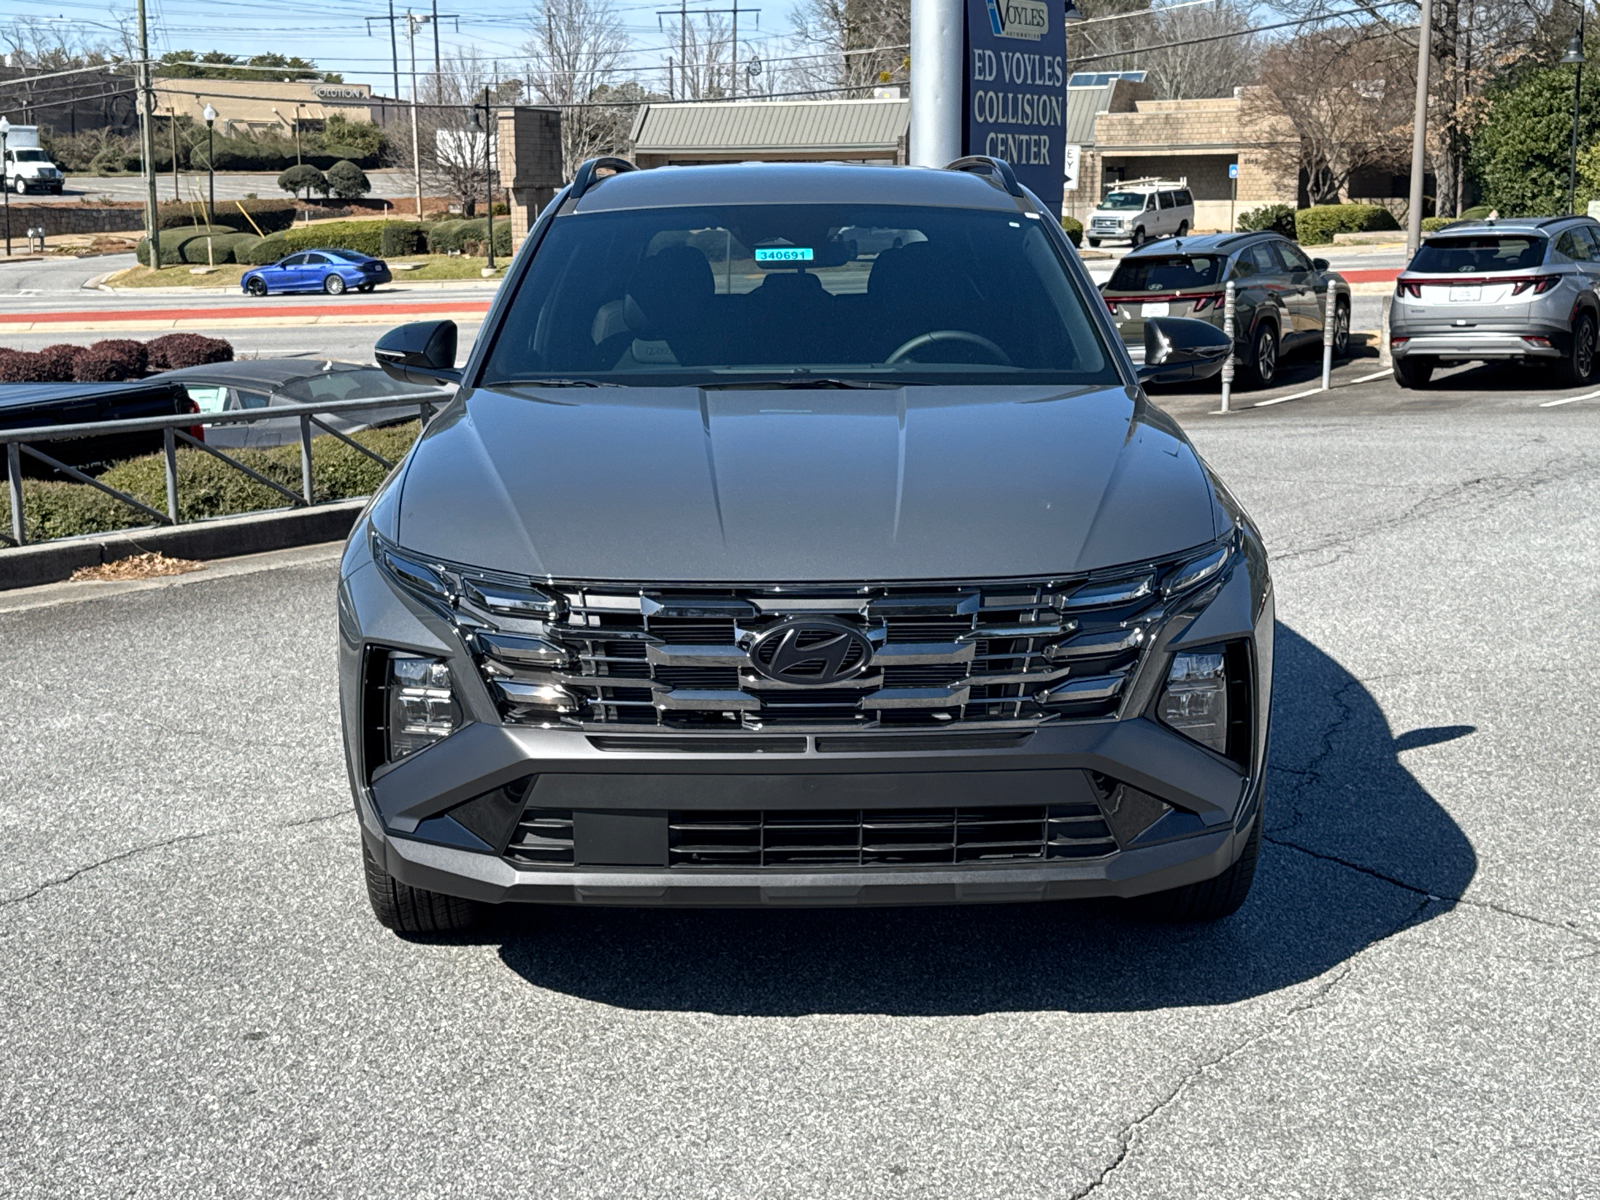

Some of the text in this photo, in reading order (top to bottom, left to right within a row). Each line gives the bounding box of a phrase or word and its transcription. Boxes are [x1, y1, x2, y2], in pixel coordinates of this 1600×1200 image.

[995, 0, 1045, 31] VOYLES
[973, 48, 1063, 87] ED VOYLES
[974, 90, 1063, 126] COLLISION
[985, 132, 1051, 165] CENTER
[760, 251, 805, 260] 340691
